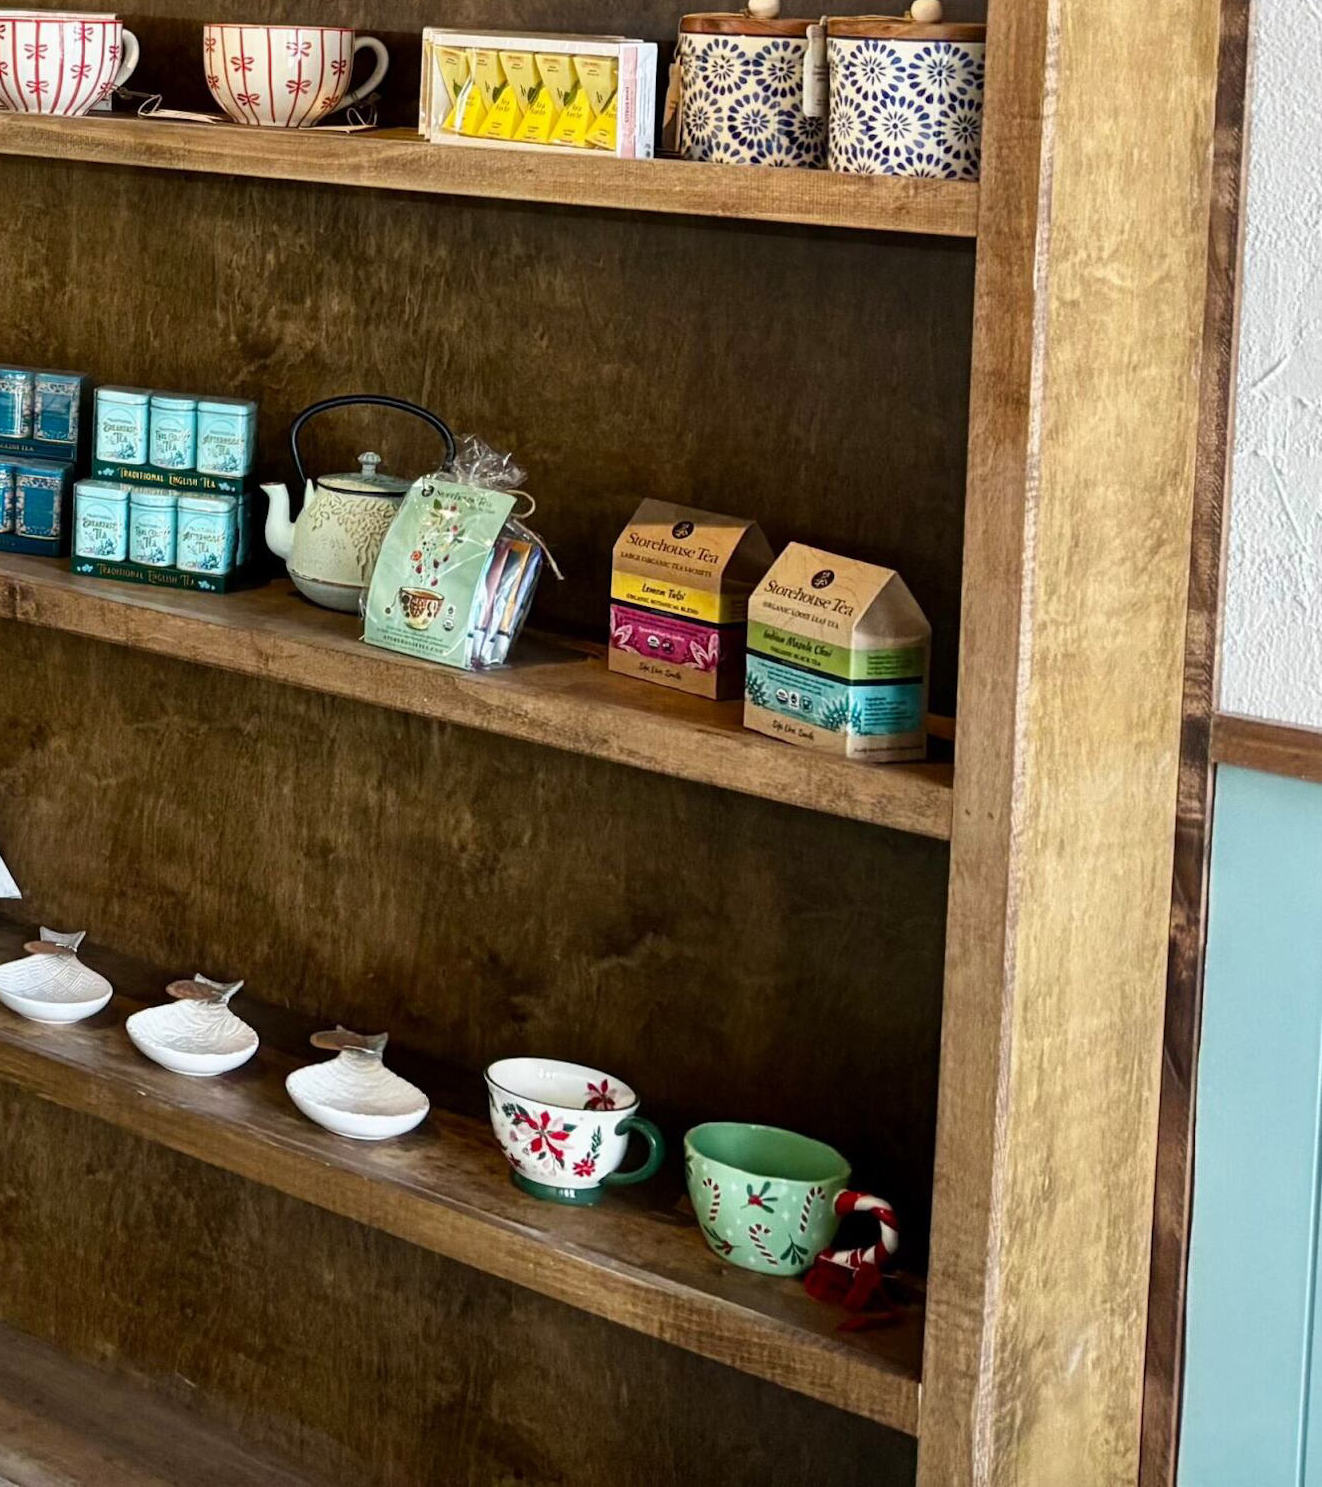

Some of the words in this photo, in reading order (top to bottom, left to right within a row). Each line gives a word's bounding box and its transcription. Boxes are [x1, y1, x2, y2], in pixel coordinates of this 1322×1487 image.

[113, 432, 128, 444] TEA
[117, 466, 164, 483] TRADITIONAL
[168, 474, 198, 487] ENGLISH
[200, 478, 216, 489] TEA
[92, 528, 107, 540] TEA
[627, 532, 696, 558] Storehouse
[697, 546, 720, 565] Tea
[641, 555, 670, 569] ORGANIC
[671, 563, 684, 572] TEA
[96, 563, 144, 580] TRADITIONAL
[147, 570, 177, 584] ENGLISH
[179, 574, 195, 587] TEA
[642, 583, 666, 597] Lemon
[764, 580, 832, 608] Storehouse
[831, 597, 855, 617] Tea
[762, 601, 791, 615] ORGANIC
[811, 615, 827, 625] LEAF
[827, 620, 839, 629] TEA
[814, 642, 833, 658] Chai
